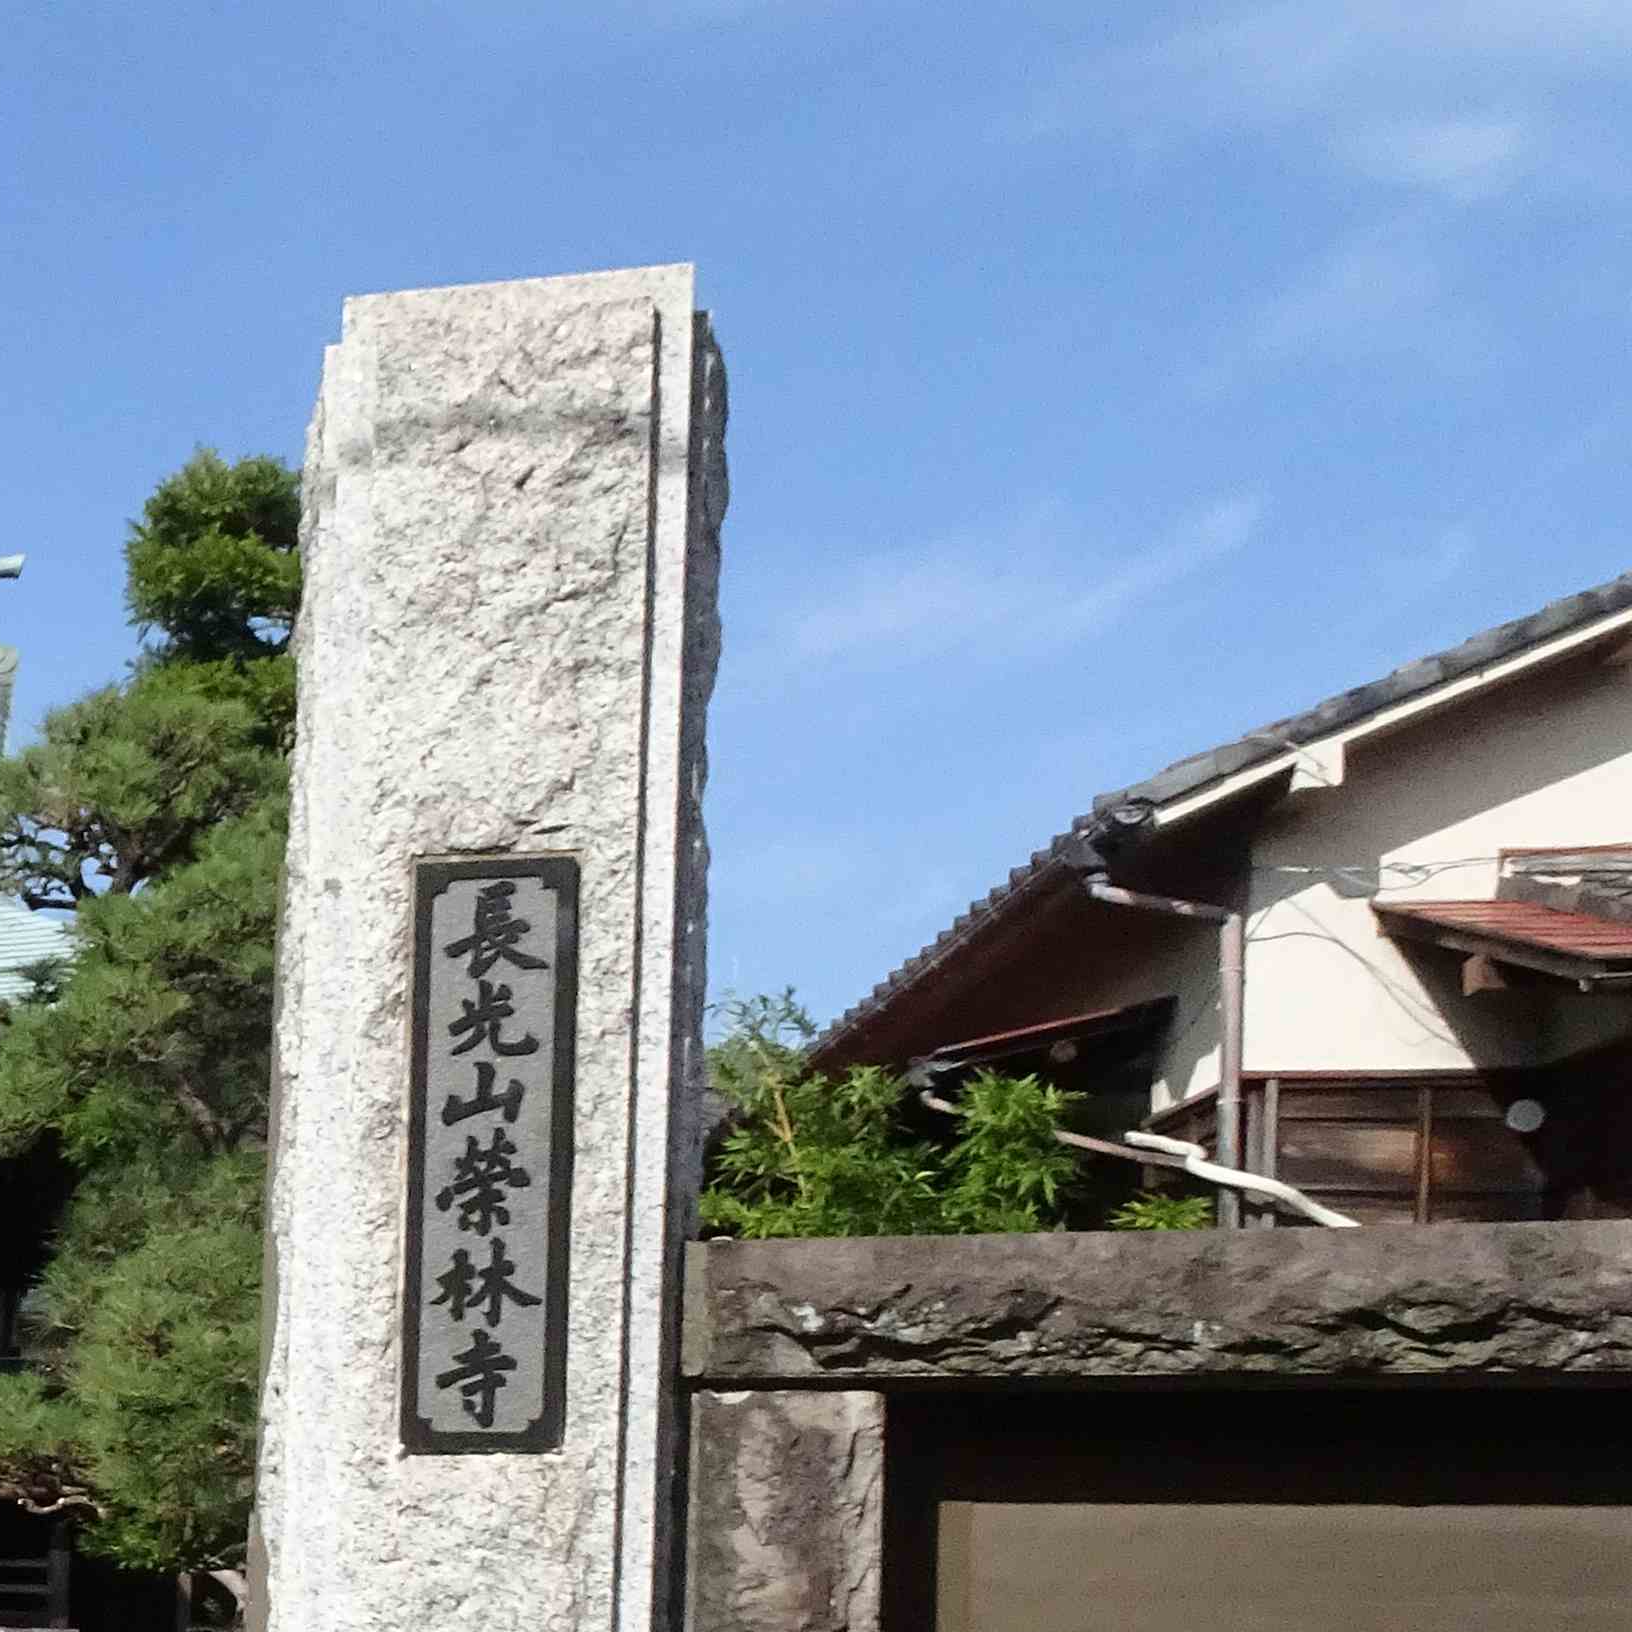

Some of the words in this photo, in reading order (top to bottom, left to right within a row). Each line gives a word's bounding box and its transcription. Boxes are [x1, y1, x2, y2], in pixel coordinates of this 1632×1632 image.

[430, 880, 551, 1429] 長光山榮林寺
